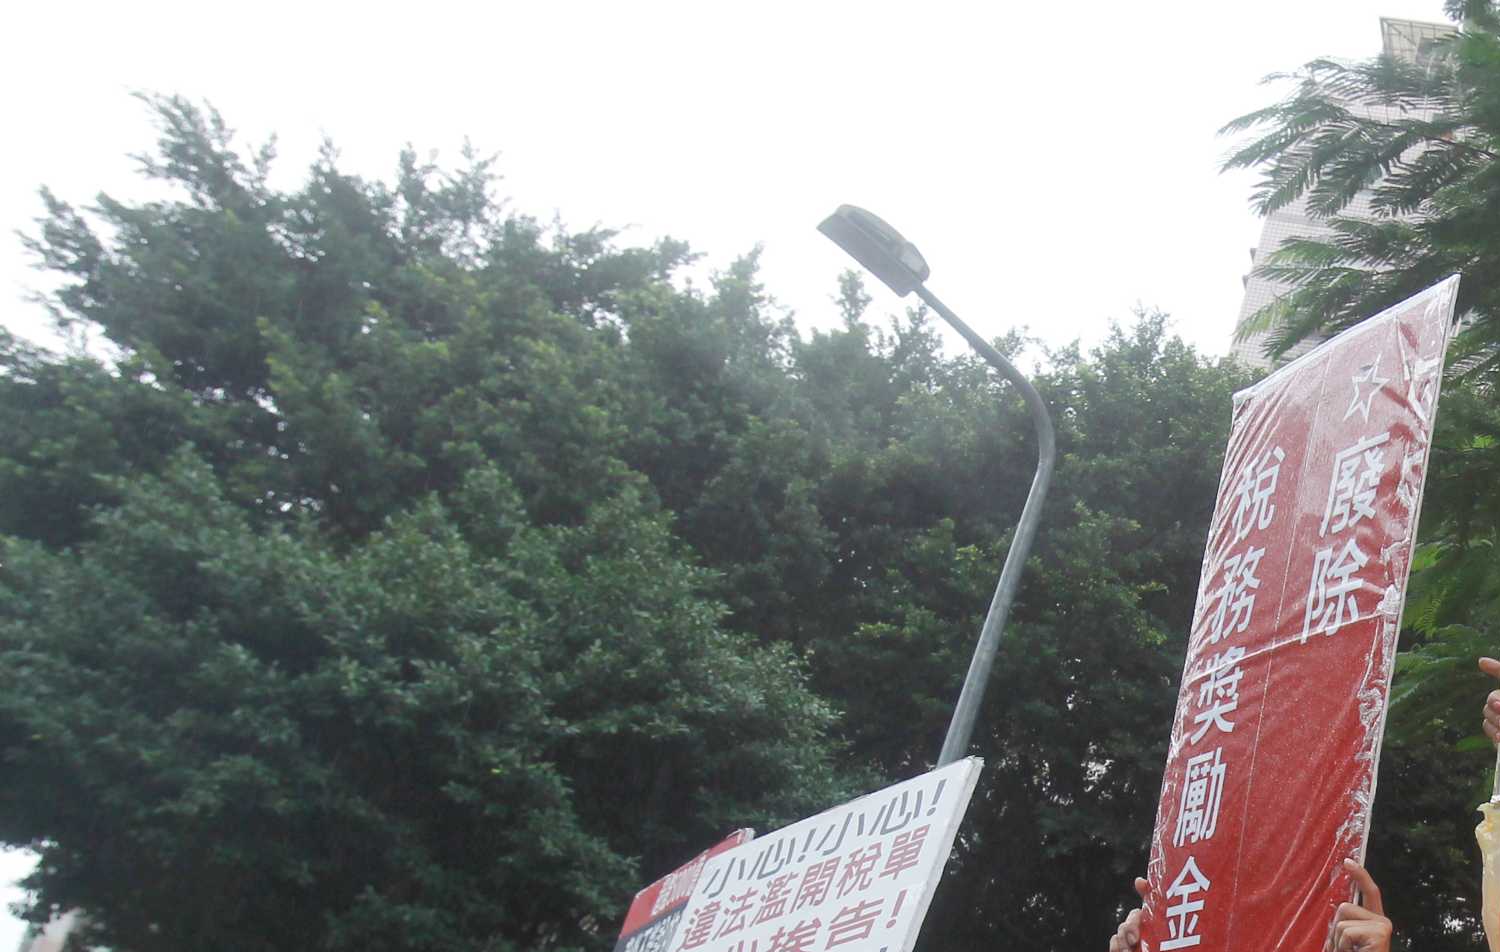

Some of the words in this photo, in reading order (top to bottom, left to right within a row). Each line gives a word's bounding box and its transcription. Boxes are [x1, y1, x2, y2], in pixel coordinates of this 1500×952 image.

[1300, 430, 1391, 645] 廢除
[1159, 444, 1285, 952] 稅務獎勵金
[675, 824, 931, 952] 違法濫開稅單
